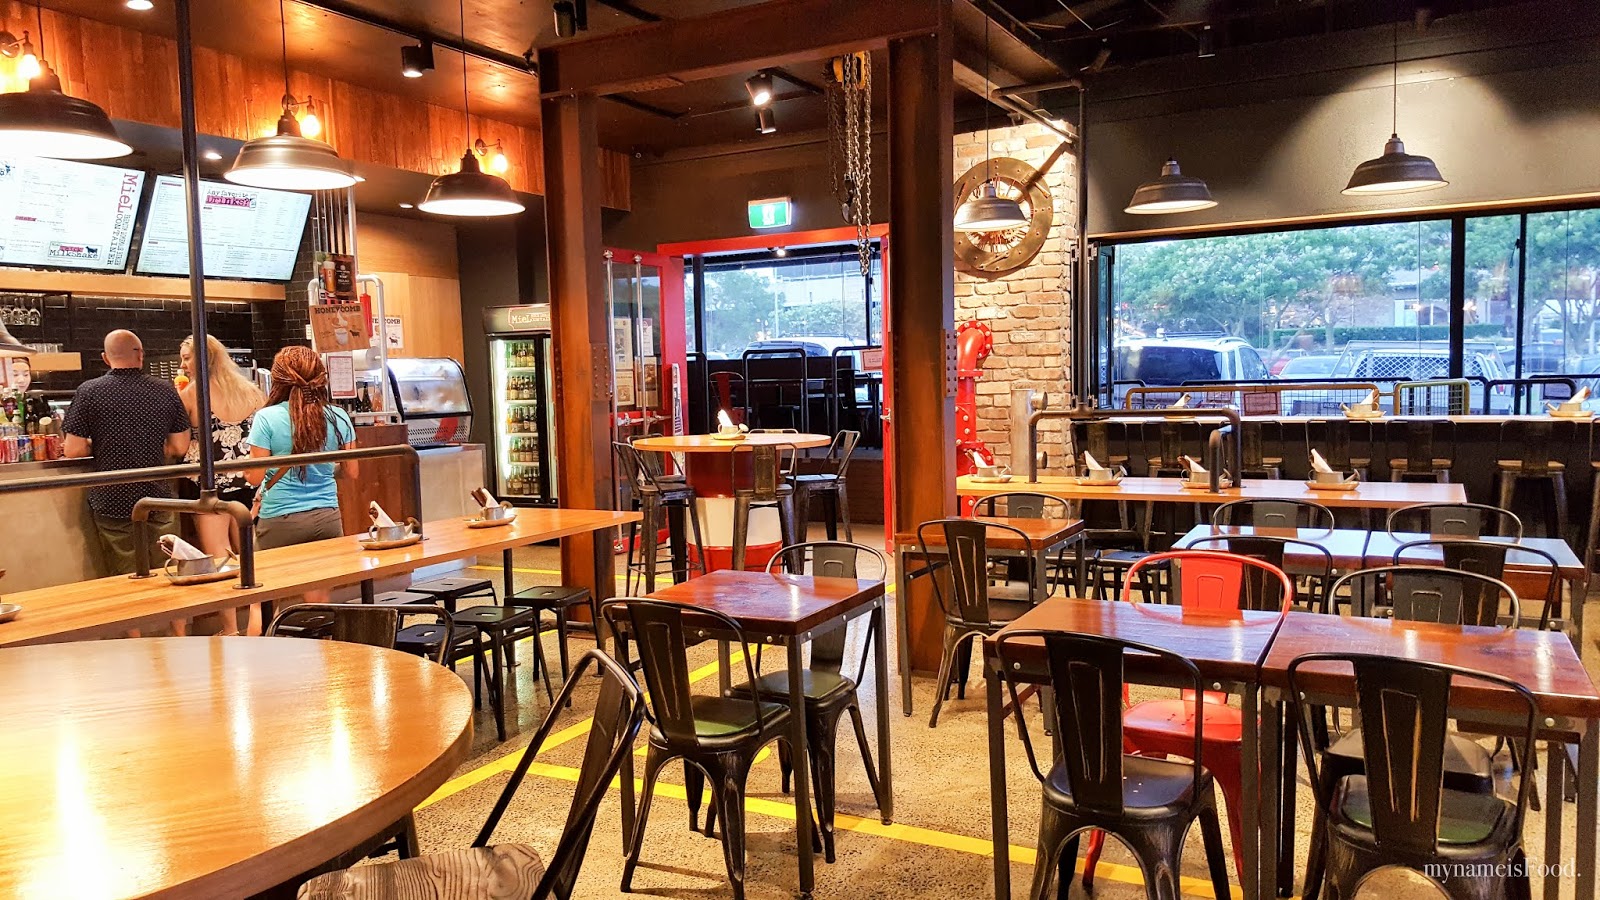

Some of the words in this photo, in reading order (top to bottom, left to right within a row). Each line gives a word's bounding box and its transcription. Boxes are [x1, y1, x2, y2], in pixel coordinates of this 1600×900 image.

[117, 173, 139, 213] MieL
[206, 195, 250, 207] Drinks?
[107, 213, 124, 266] CONTAINER
[314, 305, 361, 315] HONEYCOMB
